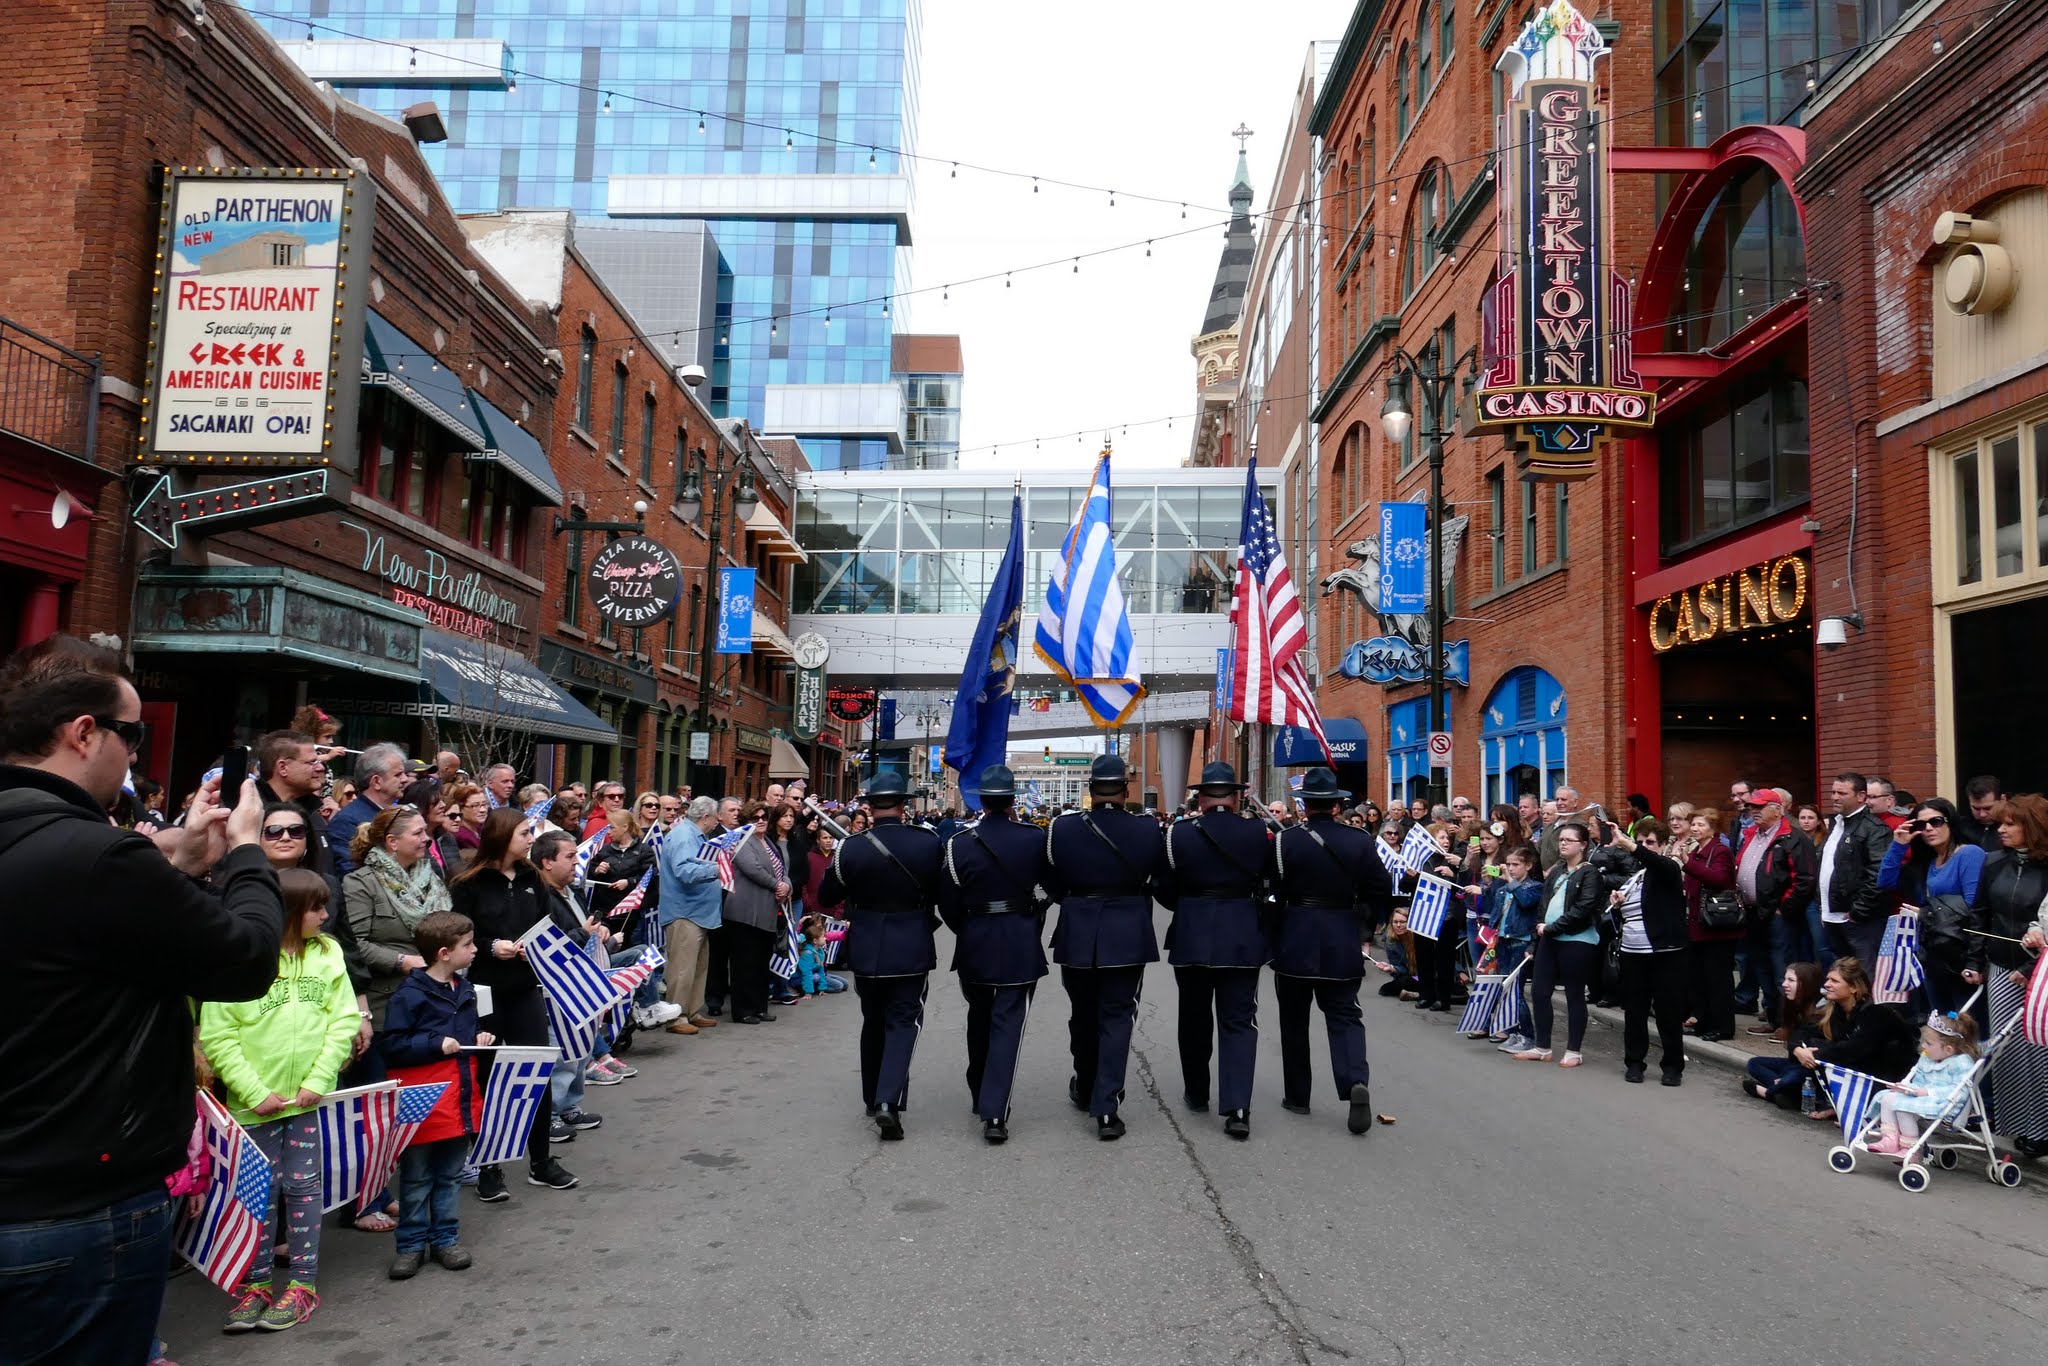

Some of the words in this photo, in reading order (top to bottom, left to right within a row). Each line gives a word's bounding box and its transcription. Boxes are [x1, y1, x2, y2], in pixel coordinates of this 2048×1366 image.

[184, 211, 211, 226] OLD
[215, 198, 333, 222] PARTHENON
[183, 231, 213, 247] NEW
[1536, 89, 1591, 384] GREEKTOWN
[178, 280, 320, 311] RESTAURANT
[204, 322, 277, 338] Specializing
[280, 324, 292, 336] in
[189, 342, 284, 366] GREEK
[292, 348, 305, 367] &
[166, 370, 253, 389] AMERICAN
[260, 371, 322, 390] CUISINE
[1486, 390, 1646, 418] CASINO
[169, 414, 253, 434] SAGANAKI
[266, 415, 311, 434] OPA!
[592, 543, 625, 578] PIZZA
[631, 540, 675, 580] PAPALIS
[1381, 508, 1394, 607] GREEKTOWN
[340, 520, 423, 589] New
[425, 550, 527, 629] Parthenon
[610, 581, 654, 598] PIZZA
[1649, 553, 1806, 651] CASINO
[597, 594, 668, 621] TAVERNA
[719, 572, 731, 648] GREEKTOWN
[798, 671, 809, 727] STEAK
[808, 677, 820, 733] HOUSE
